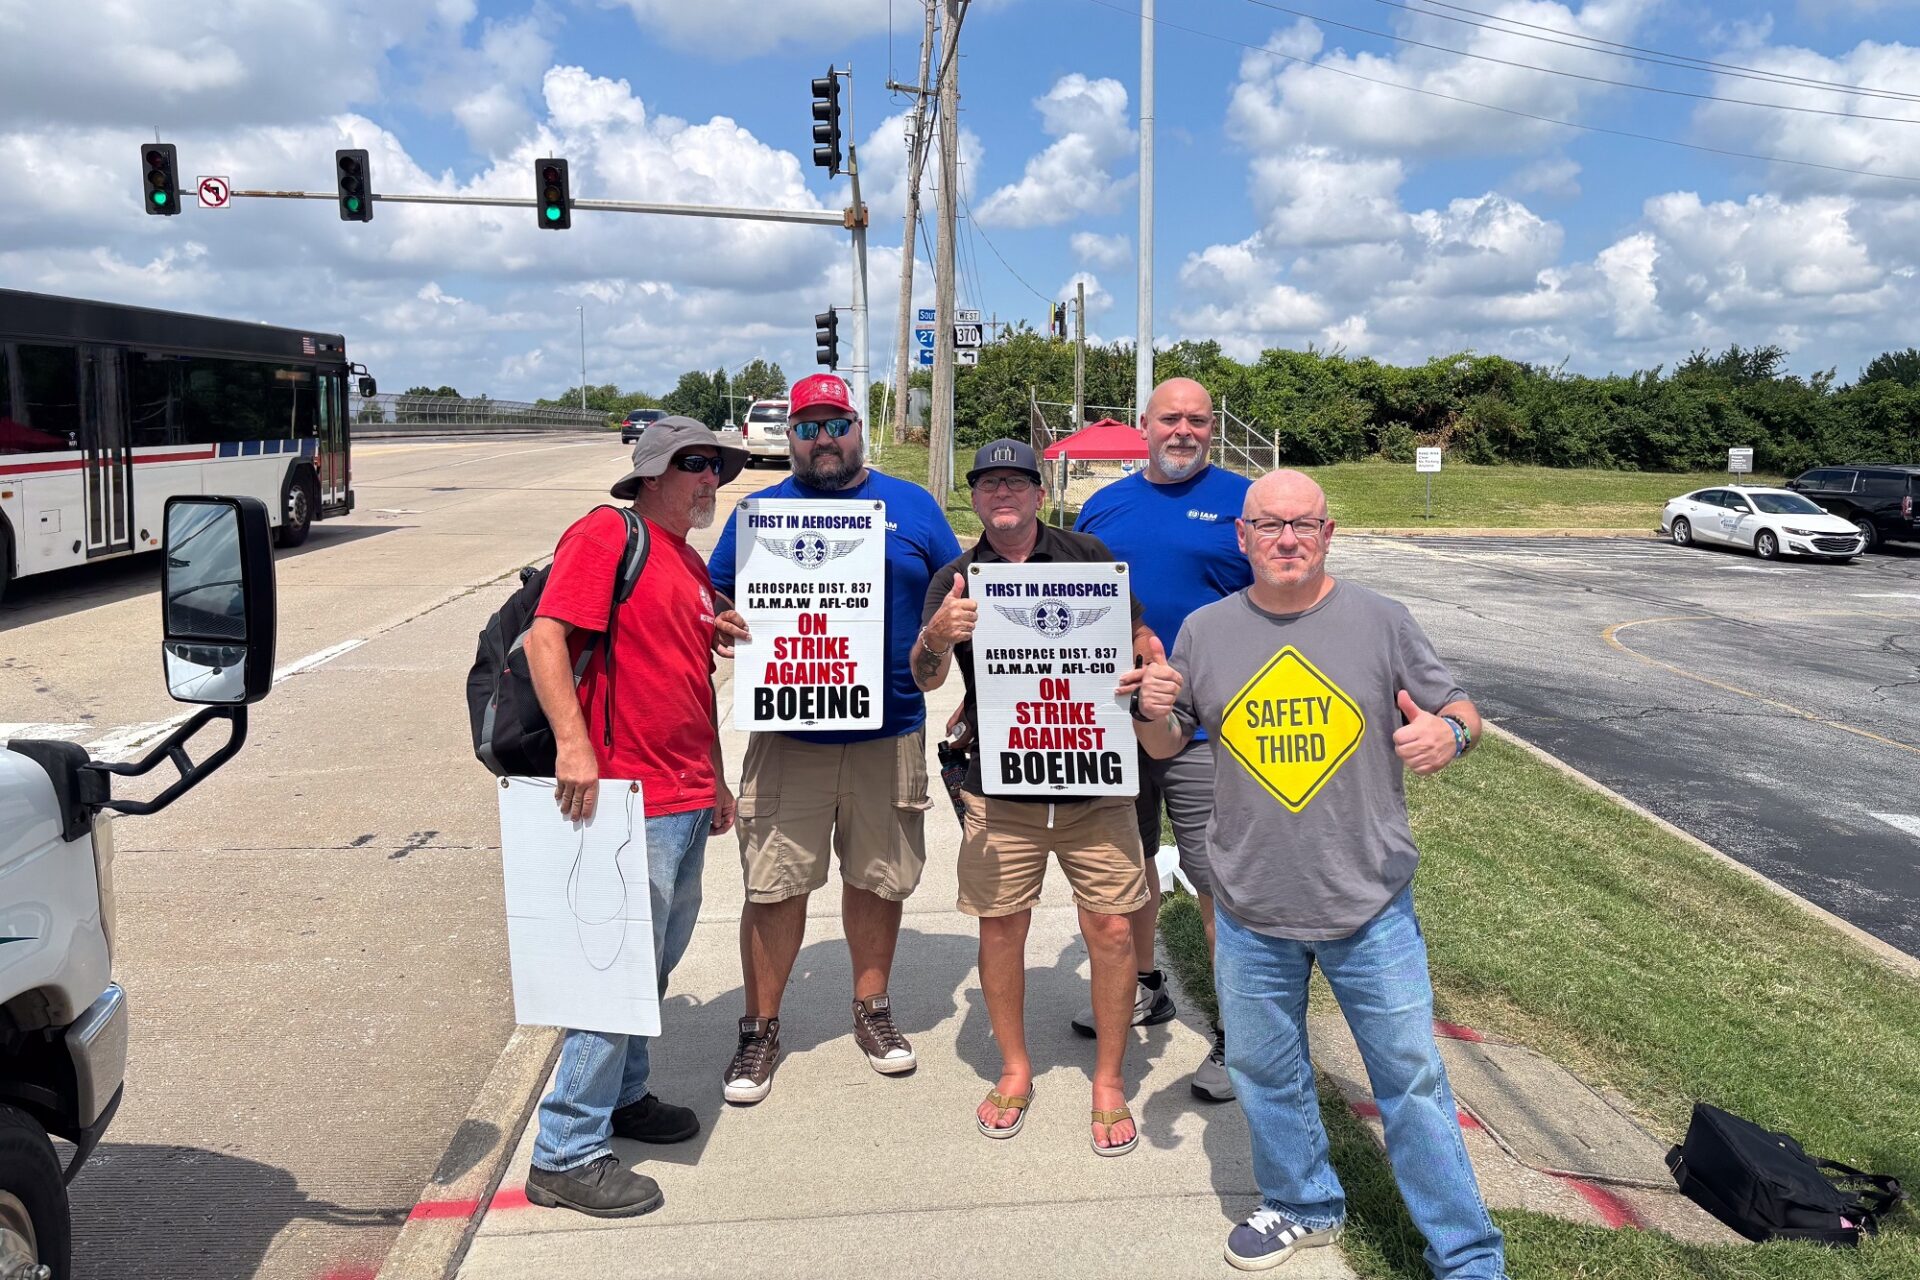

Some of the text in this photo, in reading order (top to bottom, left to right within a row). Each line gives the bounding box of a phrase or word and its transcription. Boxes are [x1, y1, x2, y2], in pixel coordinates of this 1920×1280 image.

[959, 312, 977, 320] WEST
[920, 331, 935, 343] 27
[958, 328, 977, 342] 370
[749, 515, 872, 529] FIRST IN AEROSPACE
[748, 582, 872, 594] AEROSPACE DIST. 837
[985, 583, 1118, 597] FIRST IN AEROSPACE
[749, 597, 869, 609] I.A.M.A.W AFL-CIO
[798, 613, 827, 635] ON
[774, 637, 849, 660] STRIKE
[986, 648, 1117, 660] AEROSPACE DIST. 837
[764, 662, 858, 685] AGAINST
[988, 662, 1115, 675] I.A.M.A.W AFL-CIO
[1039, 678, 1070, 701] ON
[754, 685, 870, 721] BOEING
[1016, 702, 1096, 725] STRIKE
[1245, 696, 1332, 729] SAFETY
[1008, 727, 1106, 750] AGAINST
[1256, 733, 1326, 764] THIRD
[1000, 751, 1123, 785] BOEING
